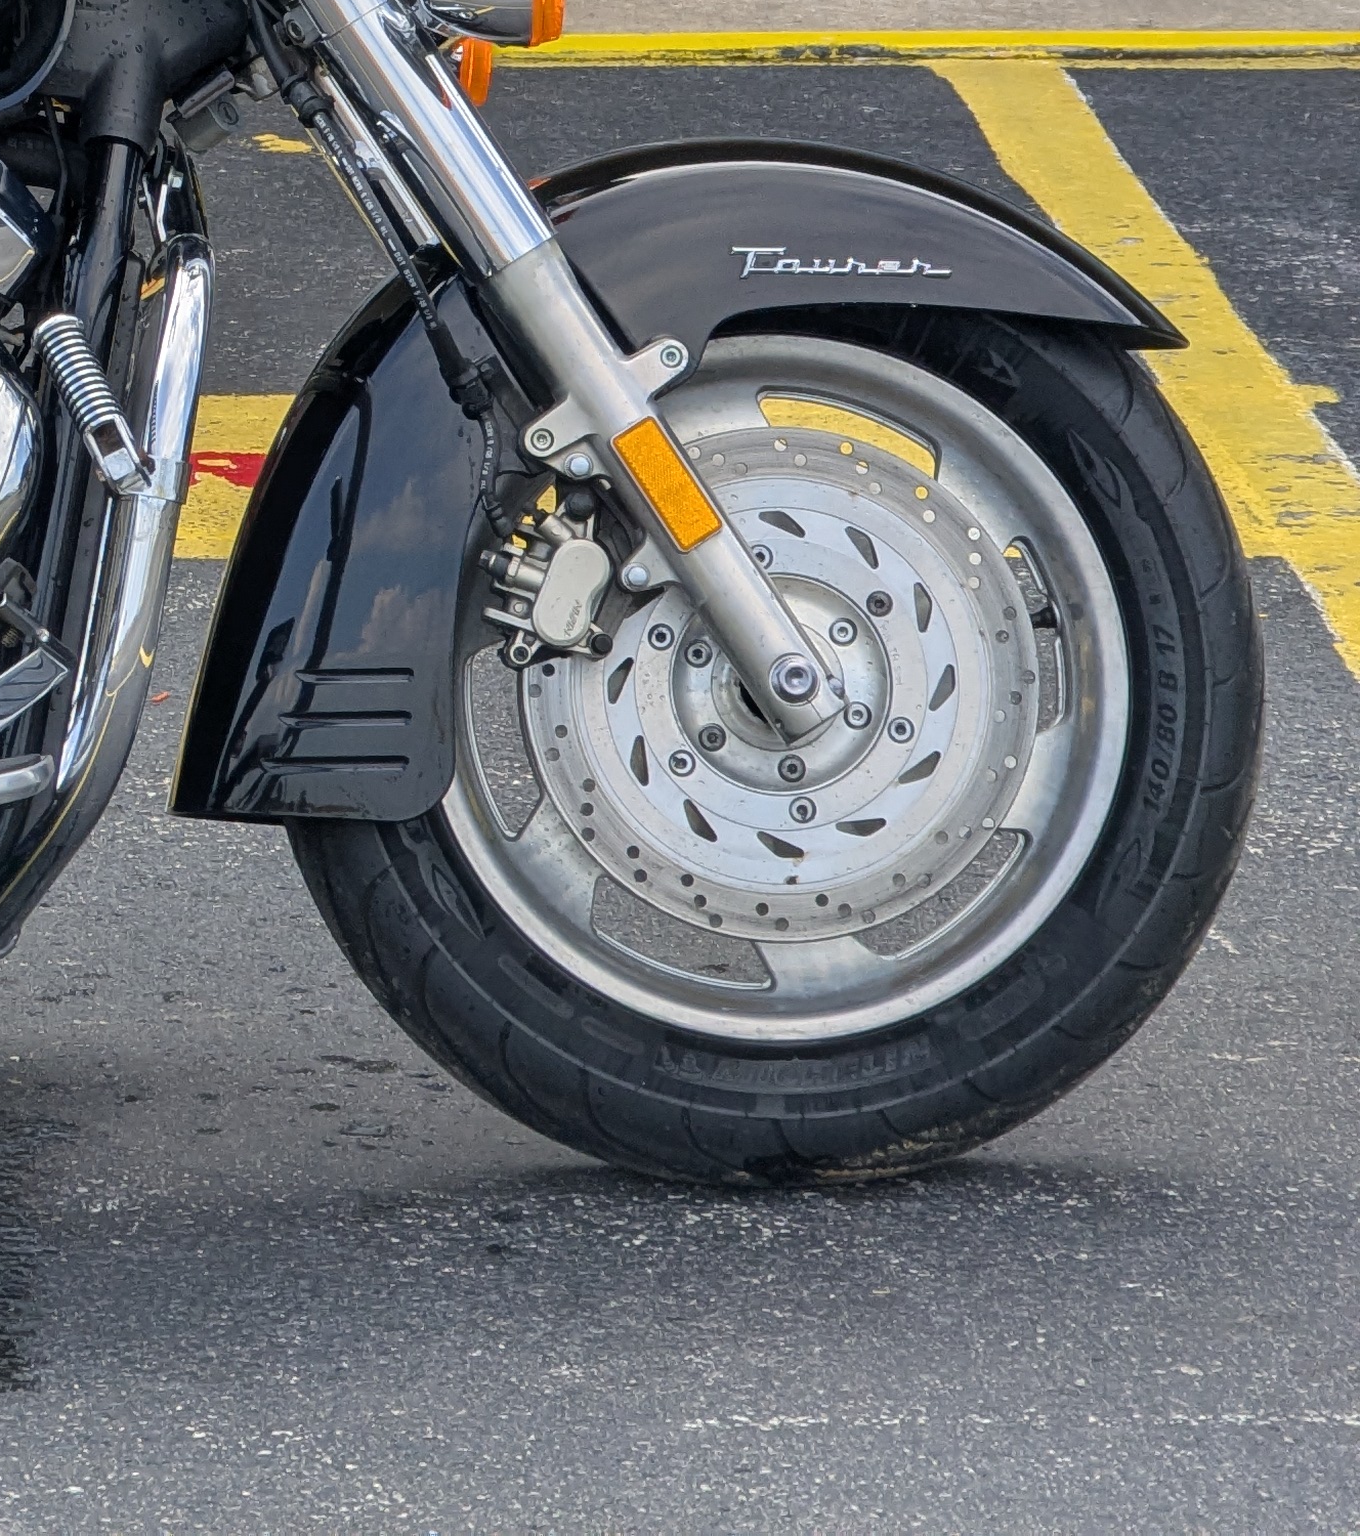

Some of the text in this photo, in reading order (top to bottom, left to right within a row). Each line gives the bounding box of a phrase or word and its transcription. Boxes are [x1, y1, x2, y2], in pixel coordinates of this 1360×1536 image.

[1151, 623, 1176, 658] 17
[1157, 668, 1178, 695] B
[1141, 703, 1178, 815] 140/80
[713, 1033, 932, 1087] MICHELIN
